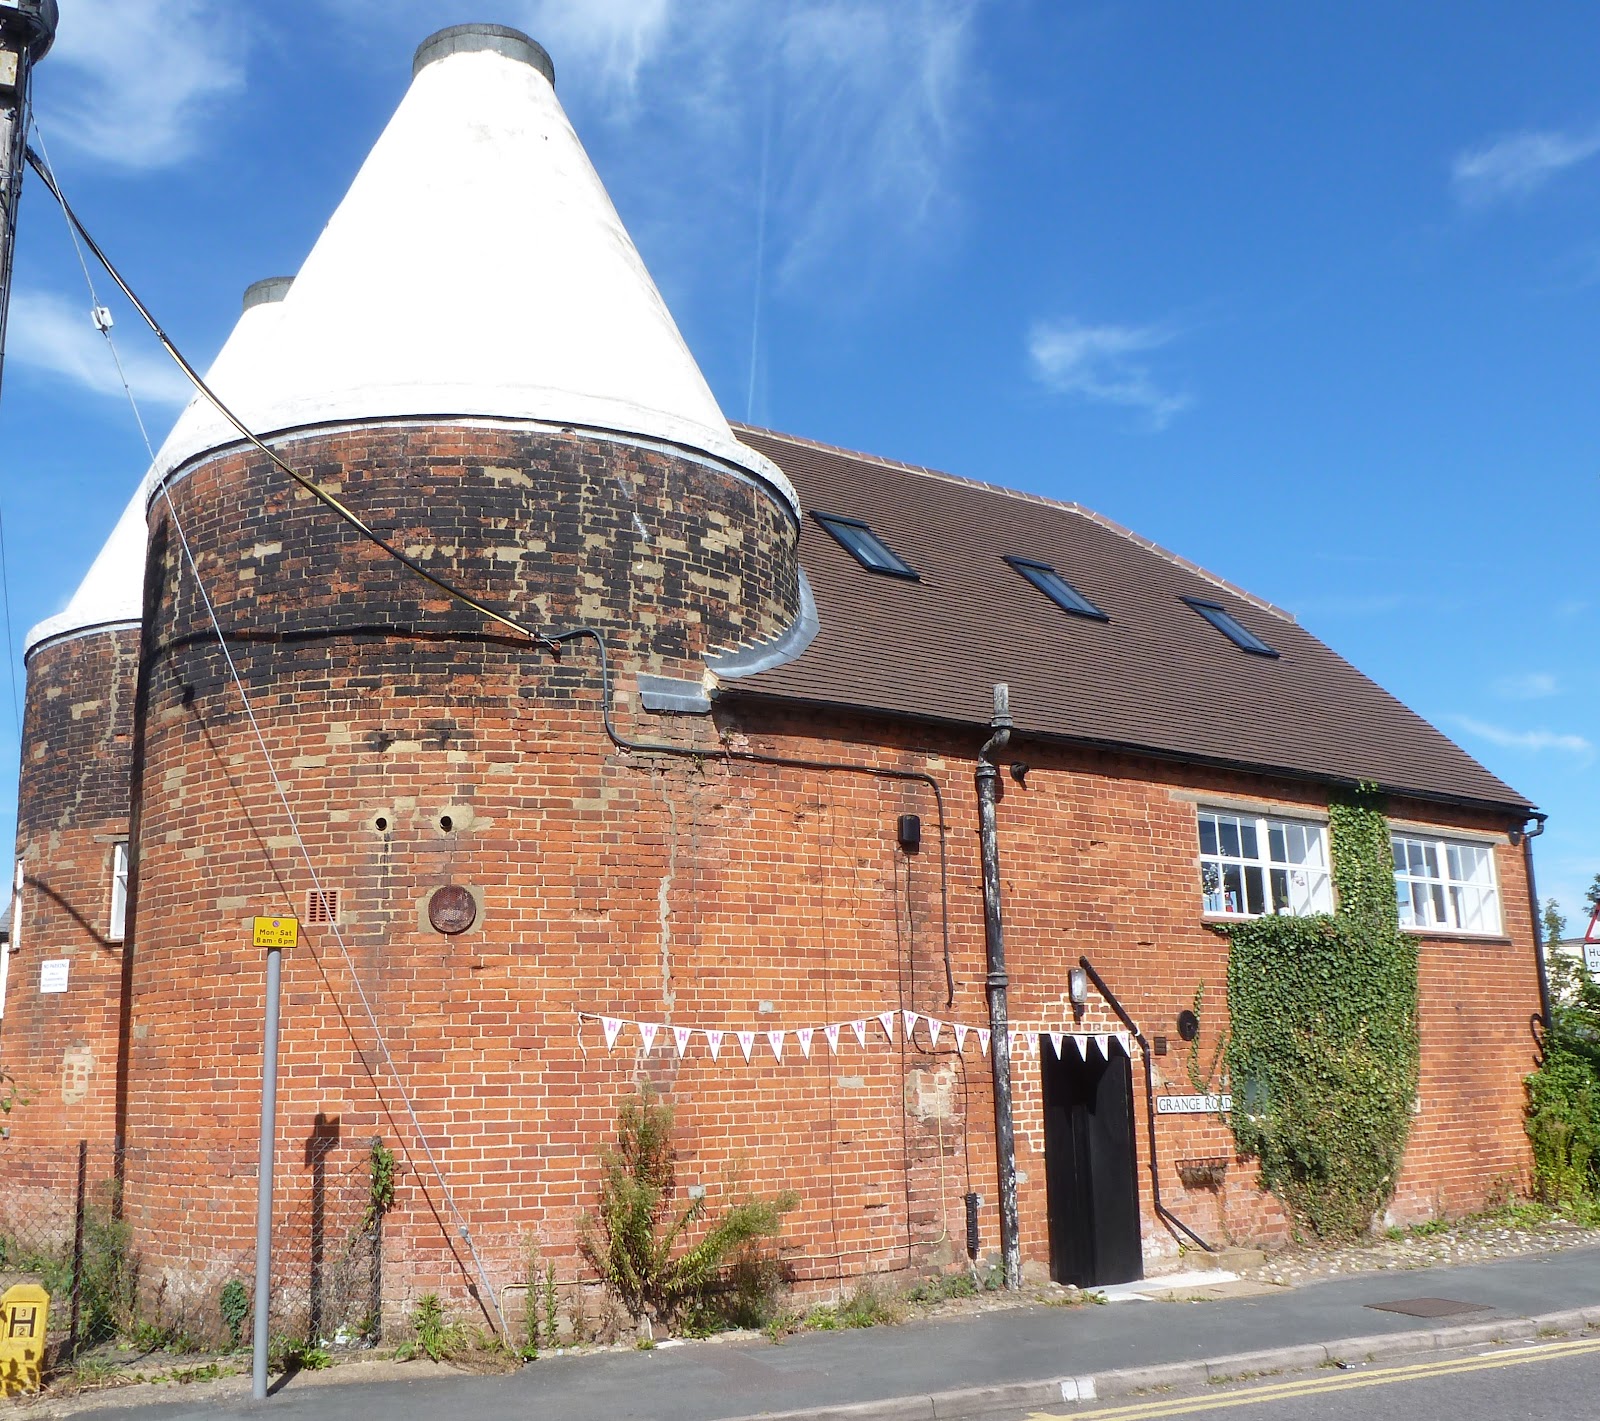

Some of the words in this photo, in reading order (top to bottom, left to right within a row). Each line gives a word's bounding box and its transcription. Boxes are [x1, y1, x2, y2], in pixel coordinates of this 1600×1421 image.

[608, 1020, 616, 1032] H
[645, 1026, 653, 1036] H
[679, 1030, 686, 1041] H
[712, 1033, 719, 1044] H
[743, 1034, 750, 1044] H
[773, 1033, 780, 1043] H
[802, 1030, 809, 1041] H
[830, 1026, 836, 1037] H
[857, 1022, 863, 1032] H
[884, 1015, 891, 1025] H
[908, 1015, 914, 1024] H
[932, 1022, 938, 1031] H
[958, 1028, 964, 1036] H
[982, 1031, 988, 1040] H
[1030, 1035, 1036, 1043] H
[1054, 1035, 1060, 1044] H
[1159, 1098, 1200, 1110] GRANGE
[22, 1309, 26, 1317] 3
[9, 1307, 36, 1337] H
[19, 1327, 24, 1335] 2
